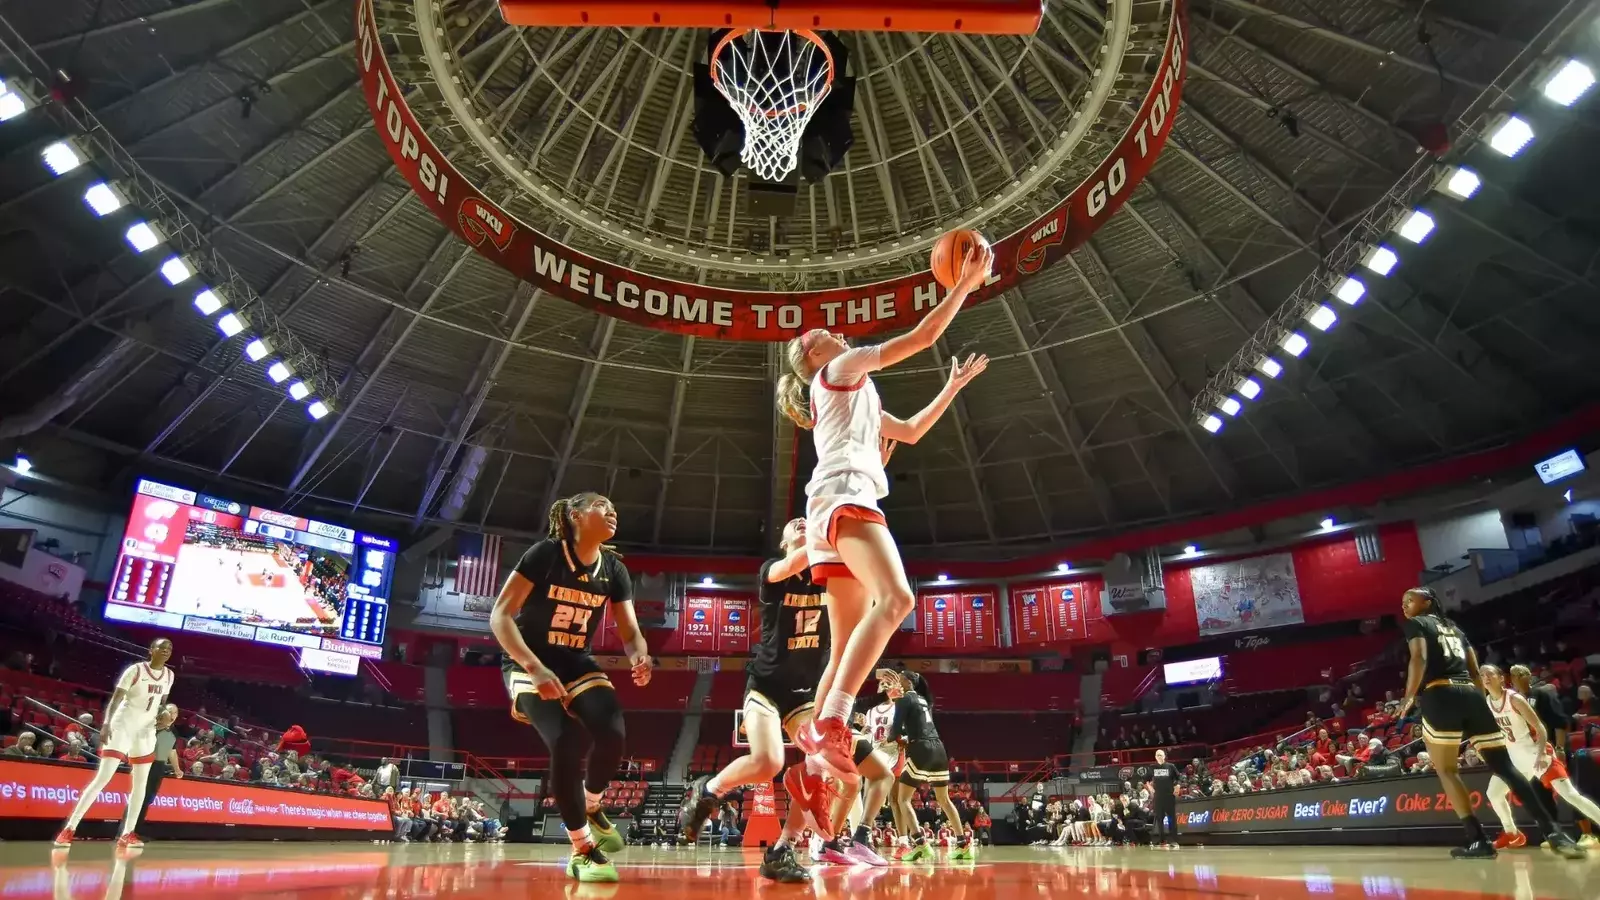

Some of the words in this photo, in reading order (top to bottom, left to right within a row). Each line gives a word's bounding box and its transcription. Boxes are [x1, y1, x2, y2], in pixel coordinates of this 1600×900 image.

[1086, 157, 1127, 218] GO
[1134, 14, 1184, 159] TOPS!
[376, 70, 449, 205] TOPS!
[475, 203, 503, 235] WKU
[1030, 218, 1058, 244] WKU
[533, 244, 733, 327] WELCOME
[751, 304, 803, 329] TO
[820, 292, 896, 327] THE
[551, 604, 593, 633] 24
[688, 623, 709, 632] 1971
[723, 625, 746, 633] 1985
[795, 610, 821, 634] 12
[270, 632, 296, 643] Ruoff
[322, 639, 382, 658] Budweiser
[548, 631, 587, 649] STATE
[787, 635, 820, 650] STATE
[31, 785, 79, 803] magic
[181, 796, 224, 811] together
[1188, 810, 1209, 824] Ever?
[1212, 808, 1230, 823] Coke
[1231, 807, 1254, 821] ZERO
[1255, 804, 1289, 819] SUGAR
[1293, 802, 1320, 818] Best
[1321, 800, 1346, 817] Coke
[1348, 796, 1387, 815] Ever?
[1395, 793, 1431, 813] Coke
[279, 803, 306, 816] There's
[306, 804, 326, 819] magic
[326, 807, 343, 819] when
[343, 810, 352, 819] we
[352, 809, 367, 820] cheer
[367, 812, 388, 823] together
